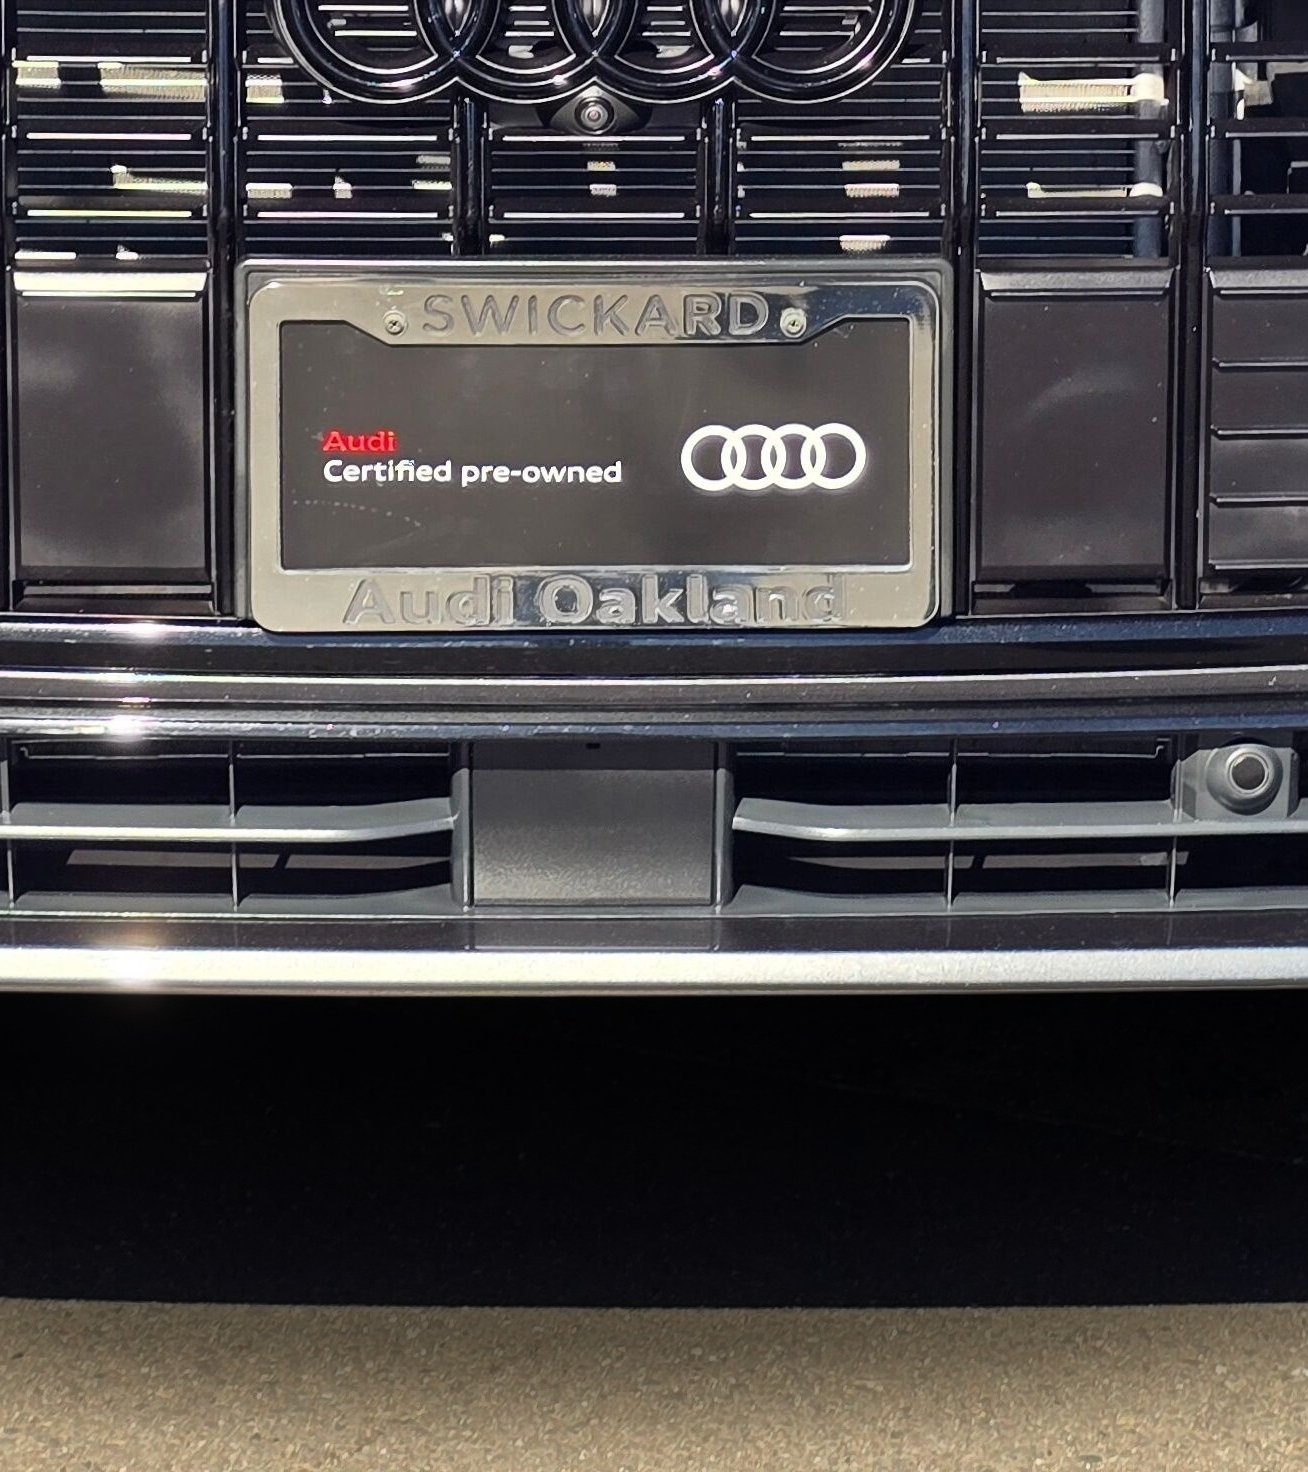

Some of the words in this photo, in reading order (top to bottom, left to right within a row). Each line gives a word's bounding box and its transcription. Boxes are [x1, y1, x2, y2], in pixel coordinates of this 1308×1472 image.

[422, 293, 769, 337] SWICKARD
[324, 431, 396, 452] Audi
[323, 458, 453, 484] Certified
[461, 459, 623, 485] pre-owned
[344, 577, 515, 626] Audi
[541, 575, 847, 623] Oakland
